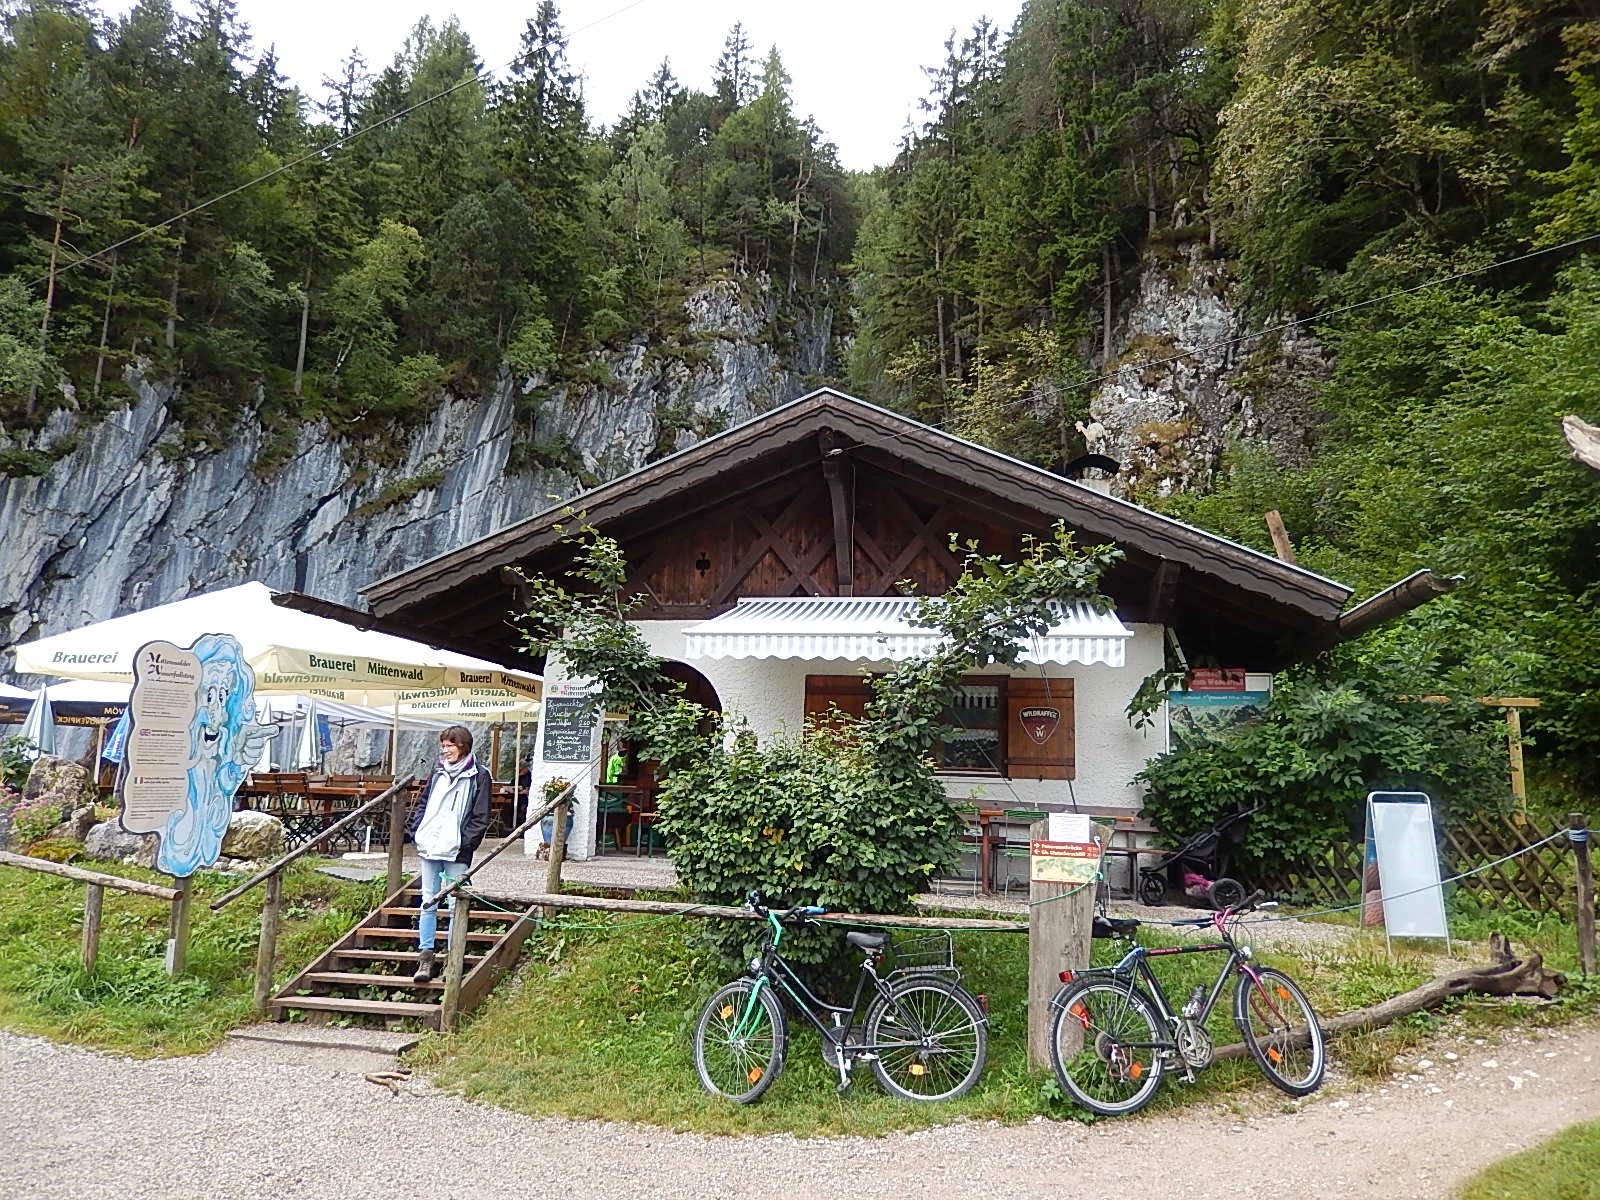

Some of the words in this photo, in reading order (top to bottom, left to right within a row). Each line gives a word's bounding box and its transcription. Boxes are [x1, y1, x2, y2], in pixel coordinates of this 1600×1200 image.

[52, 651, 119, 664] Brauerei
[309, 654, 356, 672] Brauerei
[367, 661, 424, 680] Mittenwald
[460, 672, 492, 684] Brauerei
